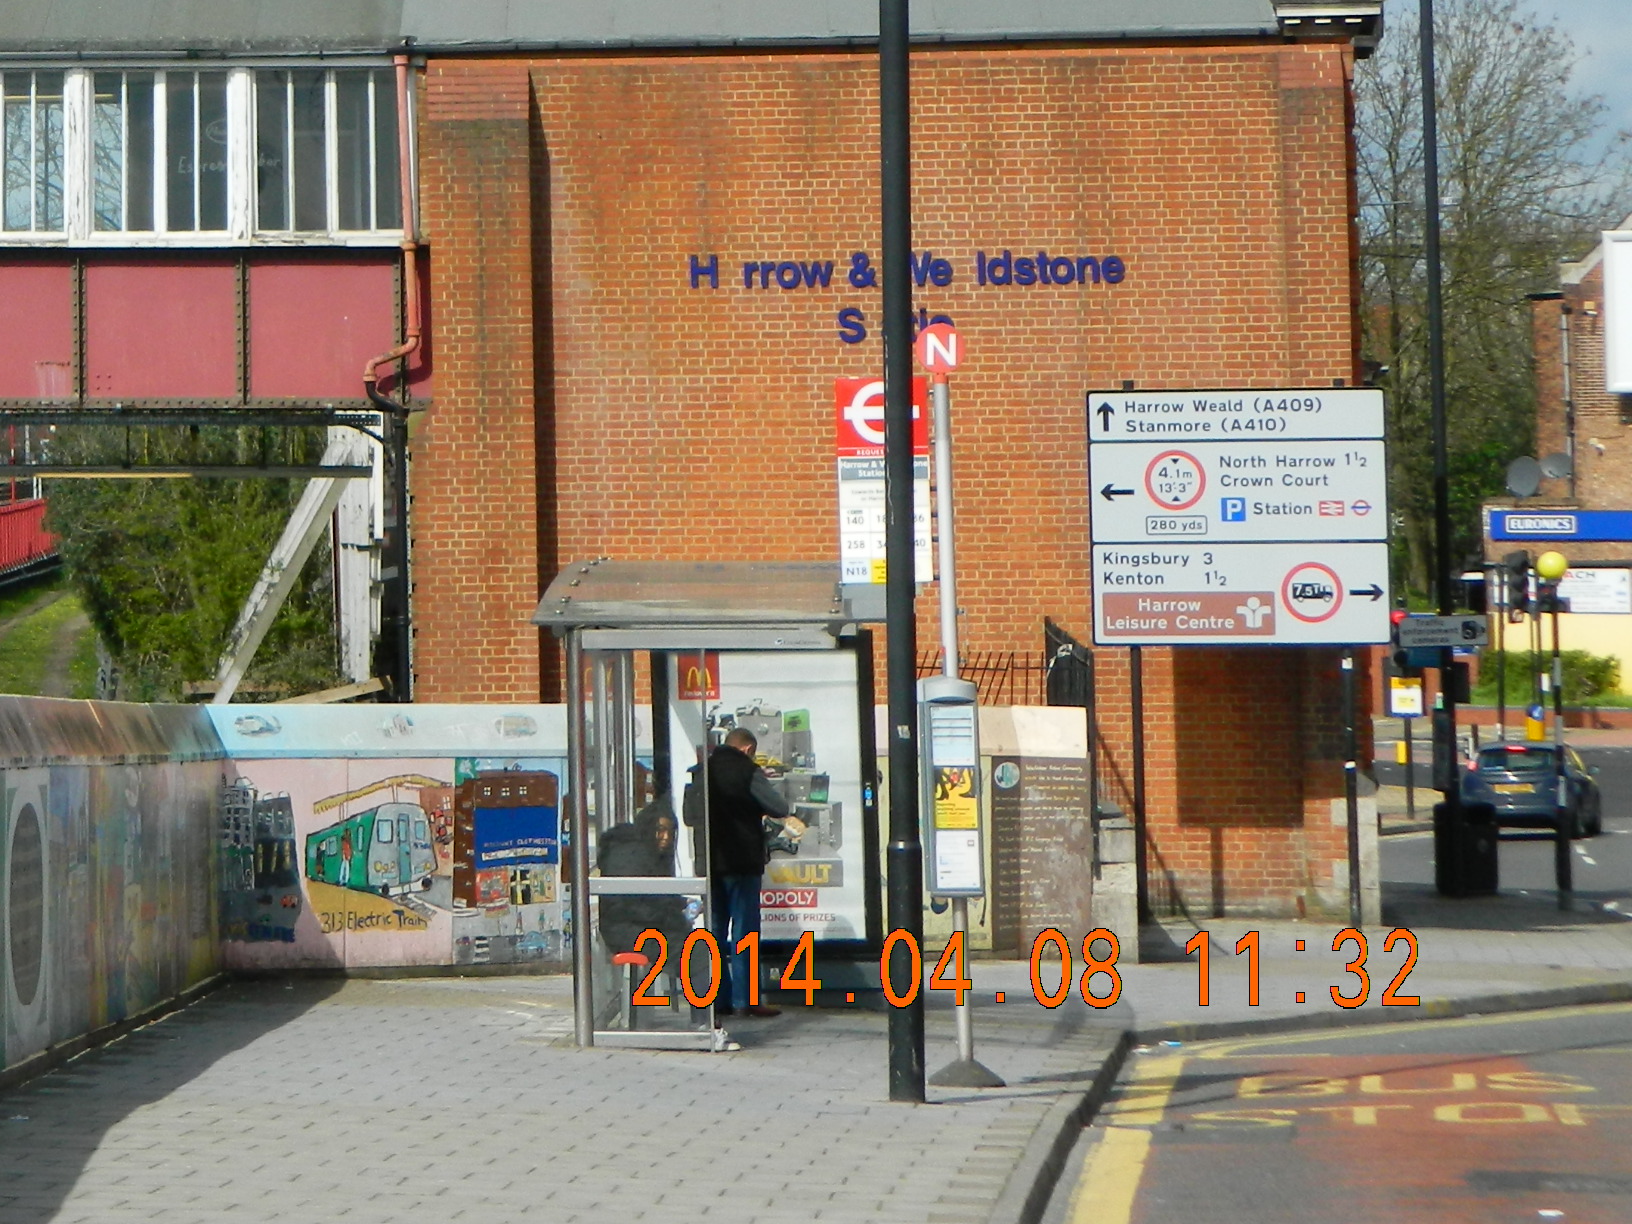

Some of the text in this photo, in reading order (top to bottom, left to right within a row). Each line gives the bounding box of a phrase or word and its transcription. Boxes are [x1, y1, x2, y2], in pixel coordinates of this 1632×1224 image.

[848, 251, 879, 289] &
[926, 333, 957, 366] N
[1124, 397, 1322, 414] Harrow Weald (A409)
[1125, 417, 1287, 433] Stanmore (A410)
[856, 448, 885, 456] REQUES
[1219, 455, 1267, 468] North
[1275, 455, 1336, 468] Harrow
[1220, 473, 1329, 487] Crown Court
[1226, 499, 1313, 520] P Station
[846, 516, 865, 525] 140
[1150, 520, 1203, 532] 280 yds
[1509, 516, 1571, 530] EURONICS
[847, 540, 866, 550] 258
[1103, 552, 1213, 567] Kingsbury 3
[846, 567, 868, 576] N18
[1103, 571, 1164, 585] Kenton
[1138, 598, 1201, 612] Harrow
[1106, 615, 1235, 629] Leisure Centre
[320, 909, 428, 934] 313 Electric Train
[788, 912, 800, 922] OF
[803, 912, 836, 922] PRIZES
[1237, 1072, 1600, 1099] BUS
